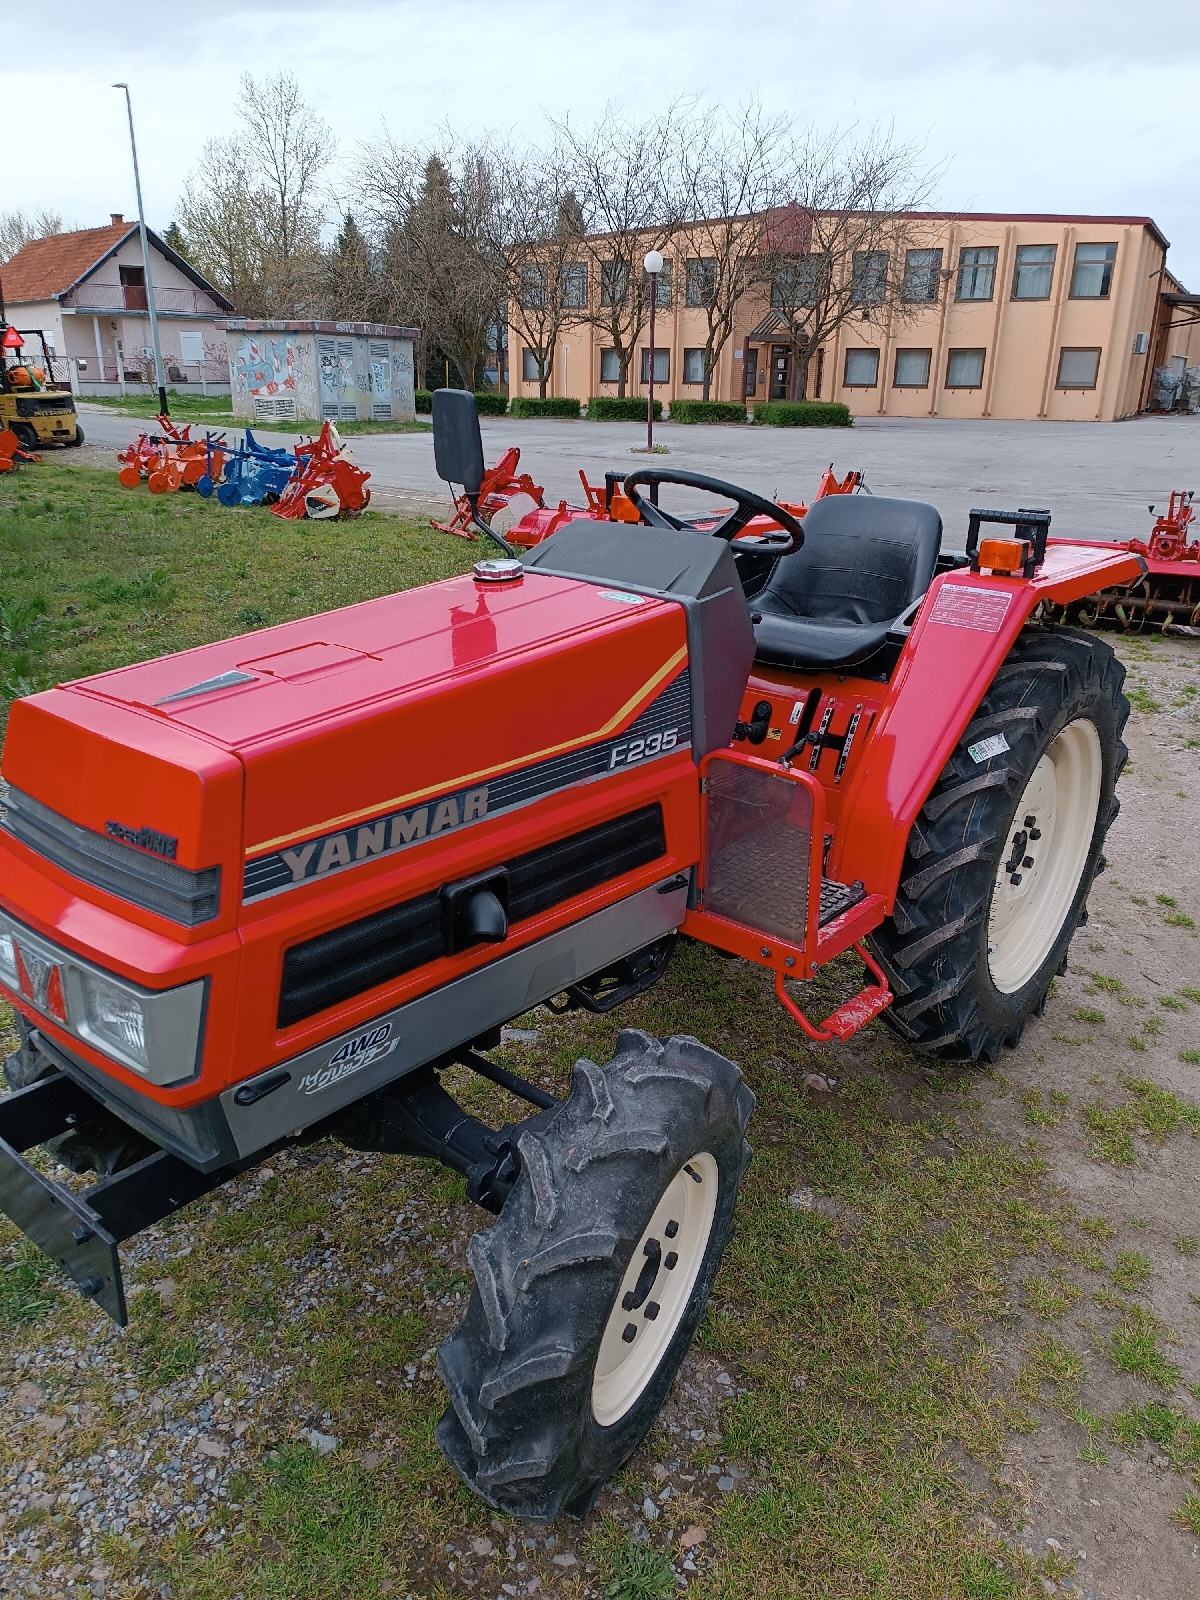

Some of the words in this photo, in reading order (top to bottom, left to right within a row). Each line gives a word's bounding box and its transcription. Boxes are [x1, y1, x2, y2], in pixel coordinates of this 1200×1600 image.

[609, 727, 679, 769] F235
[279, 785, 489, 882] YANMAR
[328, 1022, 392, 1067] 4WD
